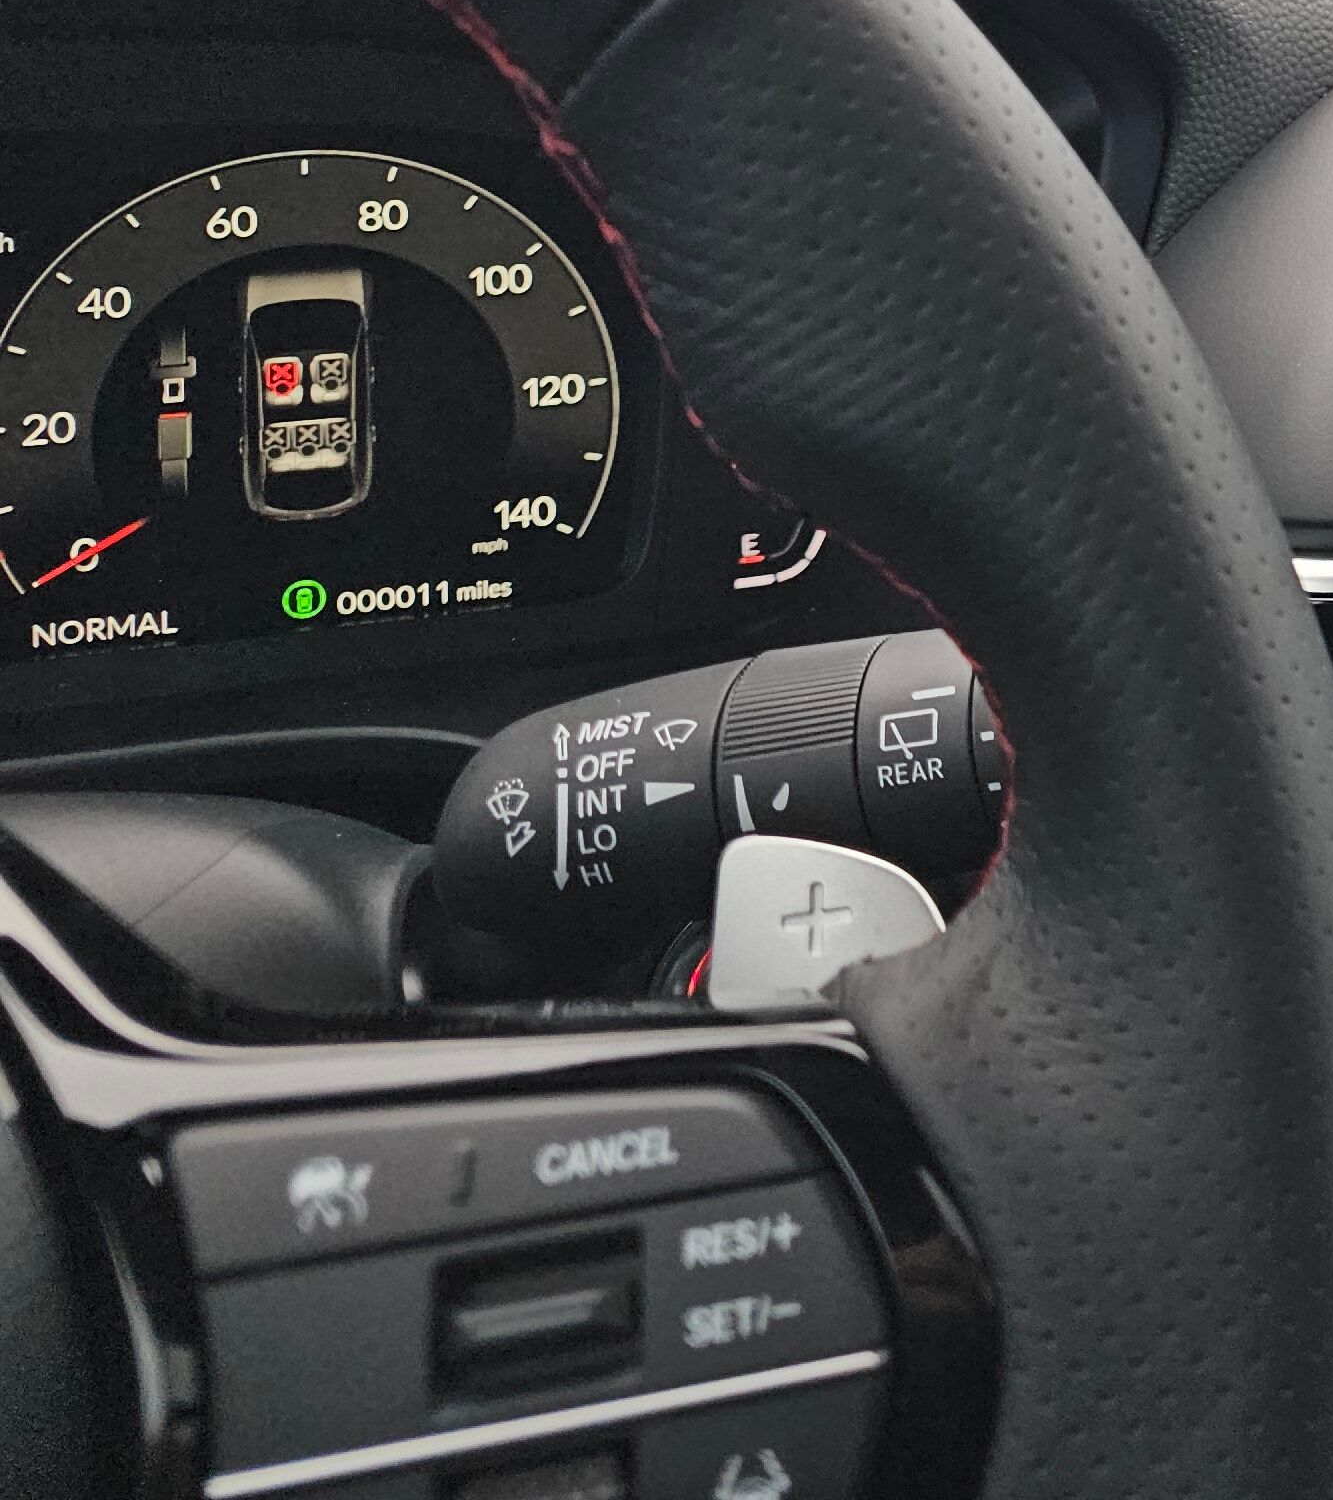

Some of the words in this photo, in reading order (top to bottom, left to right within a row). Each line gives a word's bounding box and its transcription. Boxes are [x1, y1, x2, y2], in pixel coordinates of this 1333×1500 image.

[206, 205, 258, 240] 60
[357, 199, 409, 232] 80
[468, 263, 533, 297] 100
[77, 286, 132, 320] 40
[521, 373, 586, 408] 120
[21, 411, 77, 447] 20
[493, 495, 559, 531] 140
[471, 537, 509, 556] mph
[740, 531, 762, 556] E
[336, 580, 449, 615] 000011
[455, 579, 513, 603] miles
[31, 609, 179, 649] NORMAL
[577, 711, 651, 745] MIST
[575, 747, 636, 783] OFF
[876, 755, 945, 789] REAR
[575, 783, 628, 819] INT
[576, 823, 617, 855] LO
[579, 861, 614, 887] HI
[535, 1126, 679, 1185] CANCEL
[681, 1211, 802, 1269] RES/+
